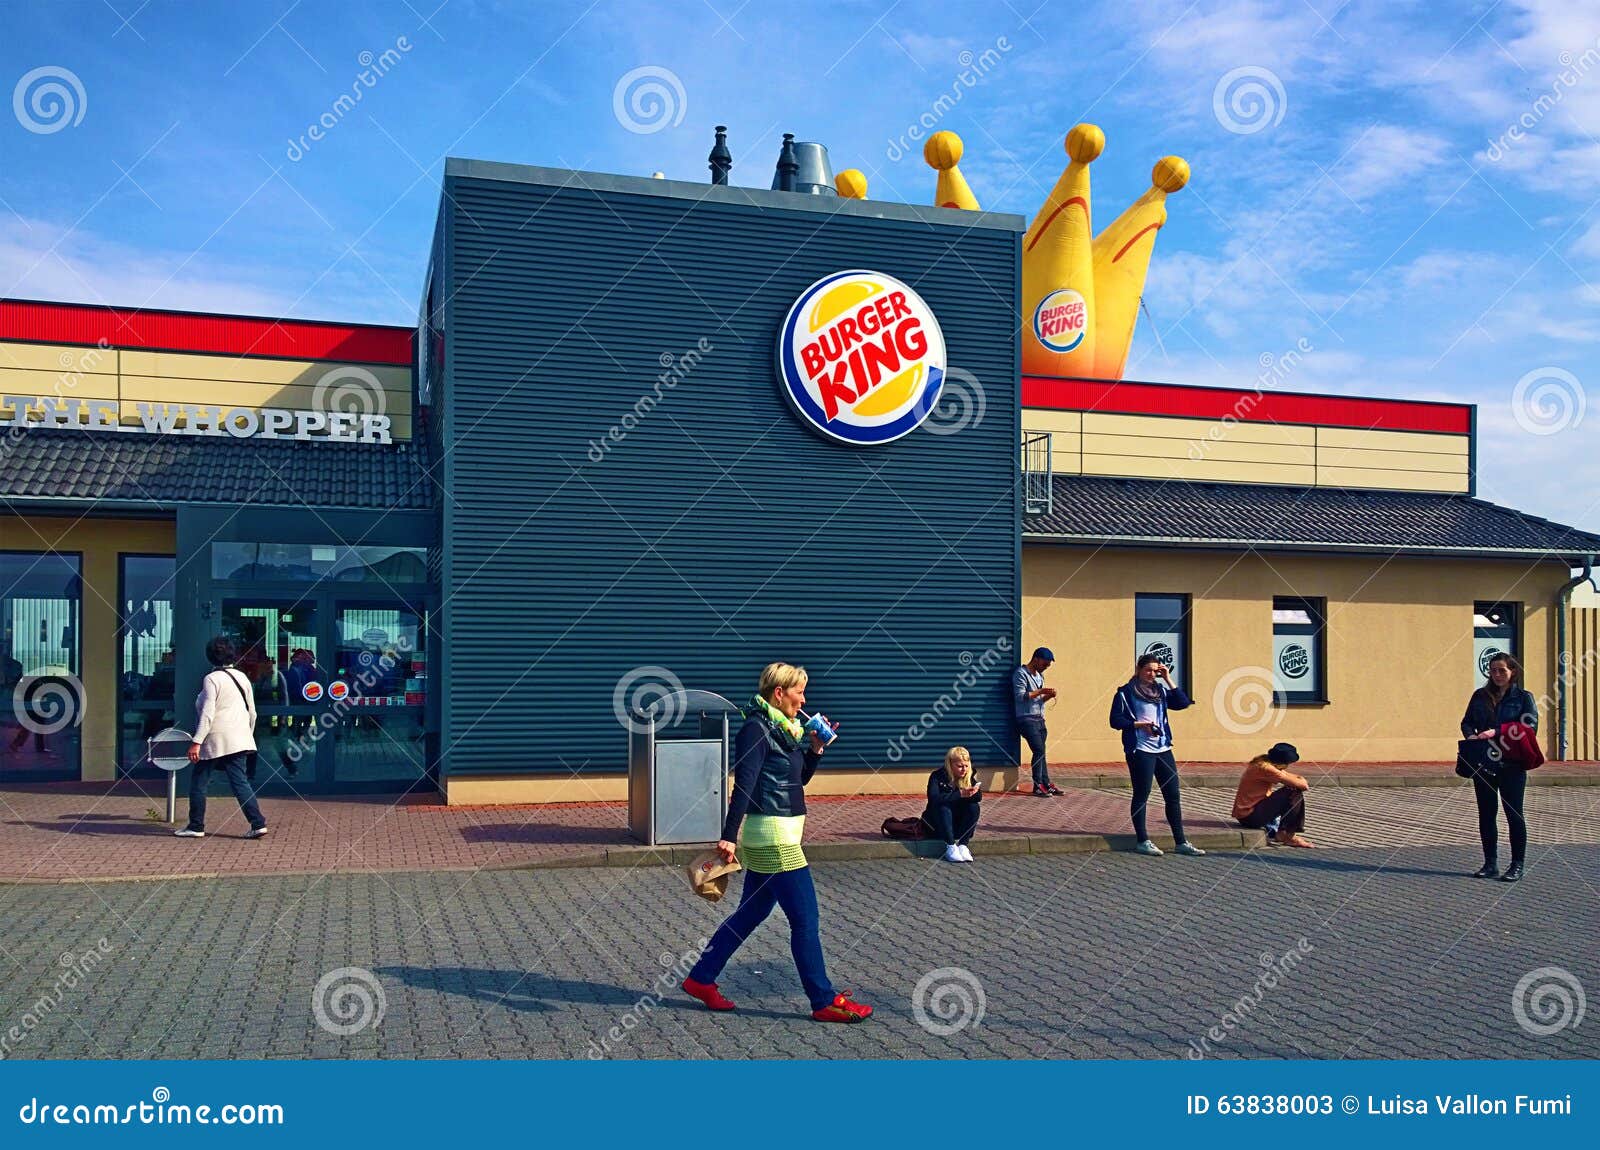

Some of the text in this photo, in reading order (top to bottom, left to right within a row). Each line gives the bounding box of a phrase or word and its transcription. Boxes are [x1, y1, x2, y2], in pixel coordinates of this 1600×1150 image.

[1041, 303, 1084, 322] BURGER
[801, 291, 912, 380] BURGER
[1041, 313, 1084, 338] KING
[817, 317, 928, 421] KING
[2, 395, 393, 444] THE WHOPPER
[1282, 649, 1307, 662] BURGER
[1283, 655, 1308, 671] KING
